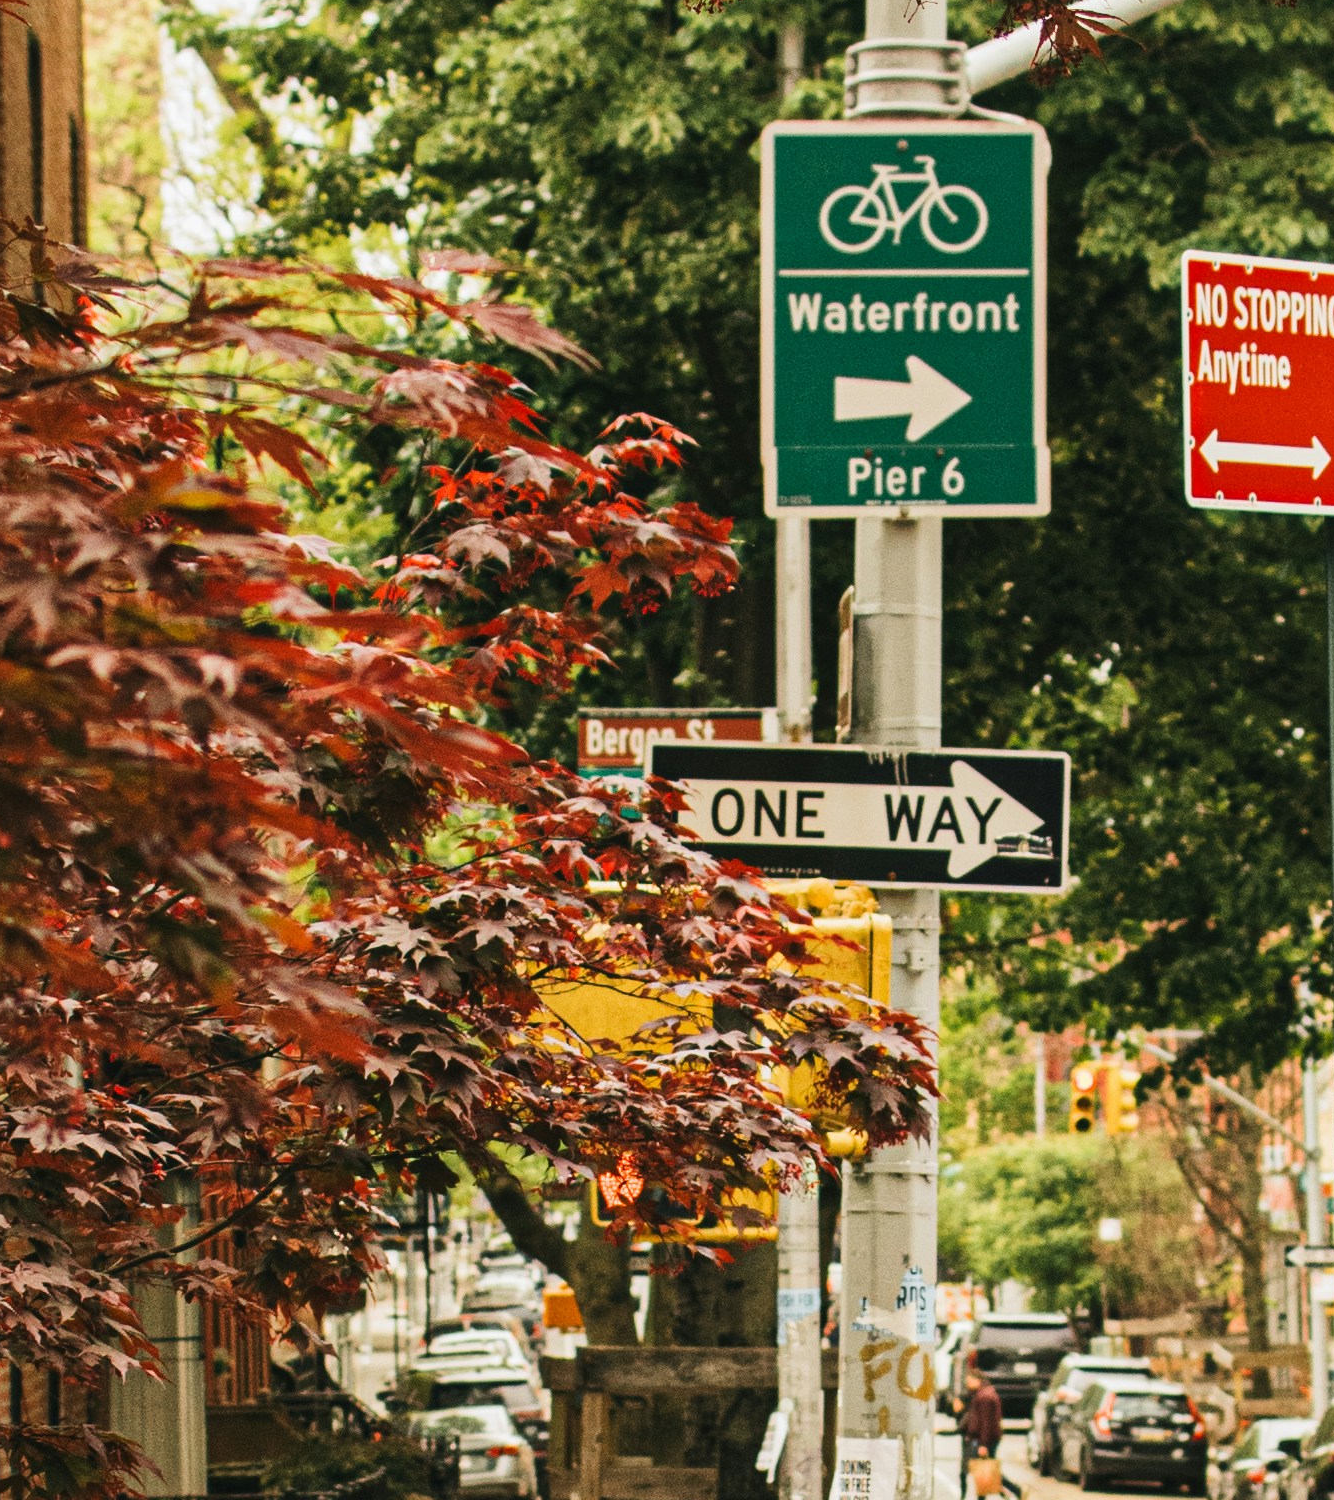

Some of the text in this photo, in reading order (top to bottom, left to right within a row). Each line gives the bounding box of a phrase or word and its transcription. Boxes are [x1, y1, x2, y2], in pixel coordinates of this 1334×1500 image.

[787, 292, 1020, 334] Waterfront
[1195, 282, 1228, 328] NO
[1197, 339, 1291, 395] Anytime
[847, 456, 965, 497] Pier 6
[710, 787, 1003, 846] ONE WAY
